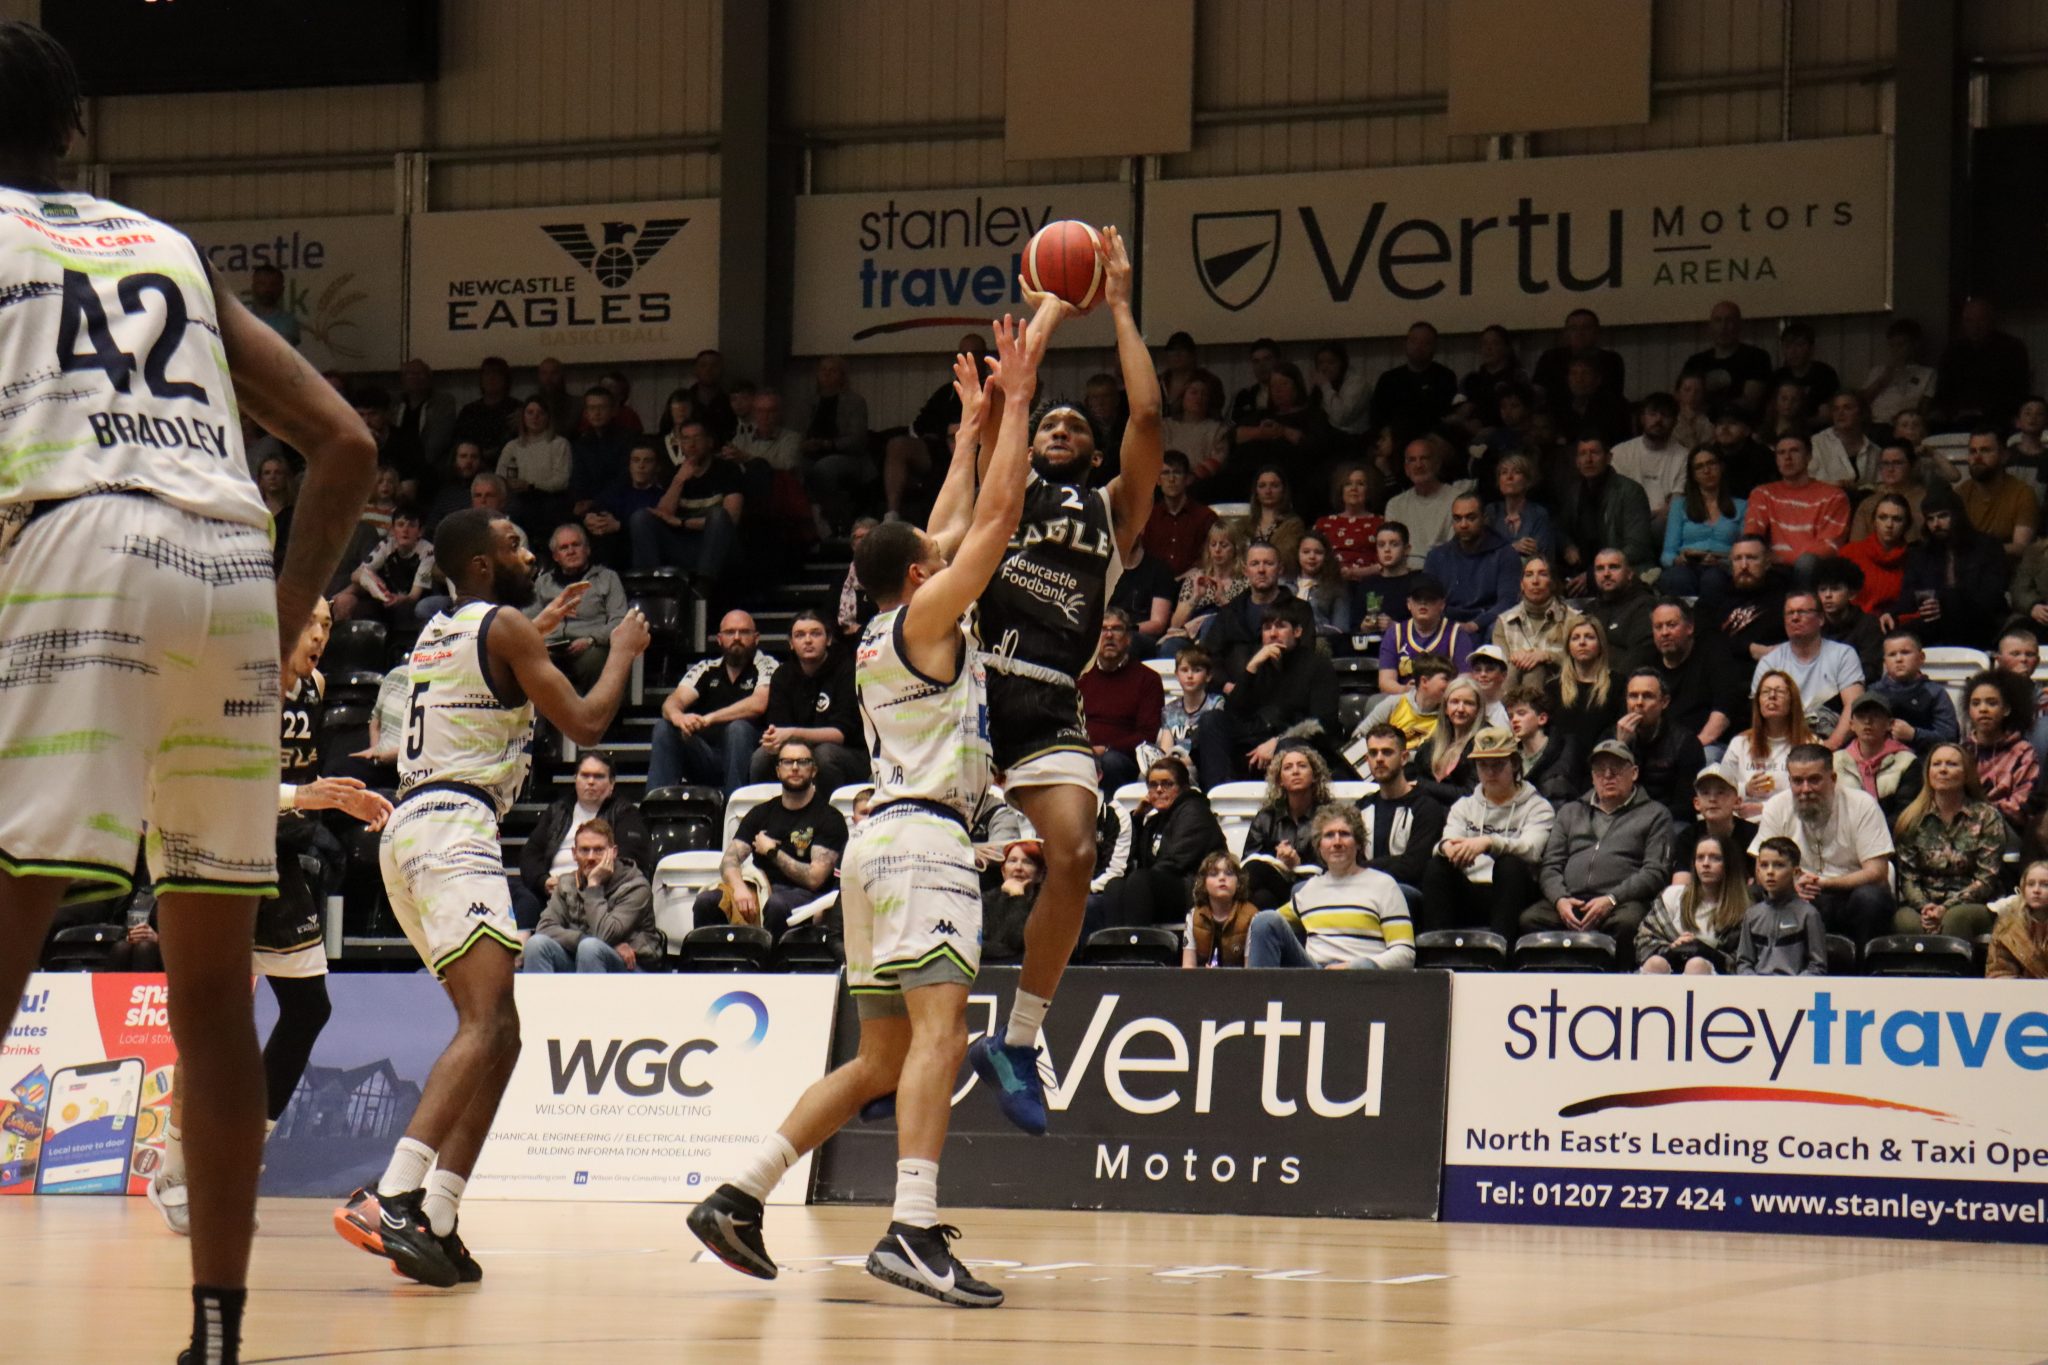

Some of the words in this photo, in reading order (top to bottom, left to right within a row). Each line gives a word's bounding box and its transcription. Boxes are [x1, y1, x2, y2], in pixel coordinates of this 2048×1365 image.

[1653, 201, 1853, 239] Motors
[96, 233, 156, 248] Cars
[203, 231, 325, 272] castle
[1298, 198, 1624, 303] Vertu
[449, 276, 575, 297] NEWCASTLE
[1653, 257, 1778, 286] ARENA
[447, 293, 671, 331] EAGLES
[57, 268, 210, 406] 42
[88, 412, 228, 458] BRADLEY
[1060, 486, 1084, 510] 2
[1001, 567, 1068, 602] Foodbank
[1006, 555, 1078, 589] Newcastle
[283, 710, 311, 739] 22
[406, 681, 431, 760] 5
[120, 1032, 149, 1045] Local
[1034, 994, 1386, 1117] Vertu
[547, 1038, 719, 1098] WGC
[535, 1103, 586, 1116] WILSON
[590, 1104, 624, 1116] GRAY
[627, 1104, 712, 1117] CONSULTING
[48, 1145, 71, 1156] Local
[72, 1144, 93, 1152] store
[105, 1139, 125, 1147] door
[487, 1132, 538, 1141] CHANICAL
[542, 1132, 612, 1142] ENGINEERING
[625, 1134, 686, 1143] ELECTRICAL
[689, 1135, 760, 1144] ENGINEERING
[527, 1146, 575, 1156] BUILDING
[577, 1146, 647, 1157] INFORMATION
[650, 1147, 712, 1157] MODELLING
[1465, 1128, 1551, 1152] North
[1560, 1129, 1642, 1154] East’s
[1652, 1133, 1768, 1163] Leading
[1778, 1135, 1870, 1161] Coach
[1880, 1139, 1903, 1162] &
[1912, 1139, 1976, 1164] Taxi
[590, 1174, 614, 1182] Wilson
[615, 1174, 631, 1184] Gray
[632, 1174, 671, 1185] Consulting
[1095, 1144, 1300, 1184] Motors
[1476, 1181, 1524, 1206] Tel:
[1532, 1183, 1612, 1208] 01207
[1621, 1185, 1667, 1210] 237
[1677, 1187, 1726, 1212] 424
